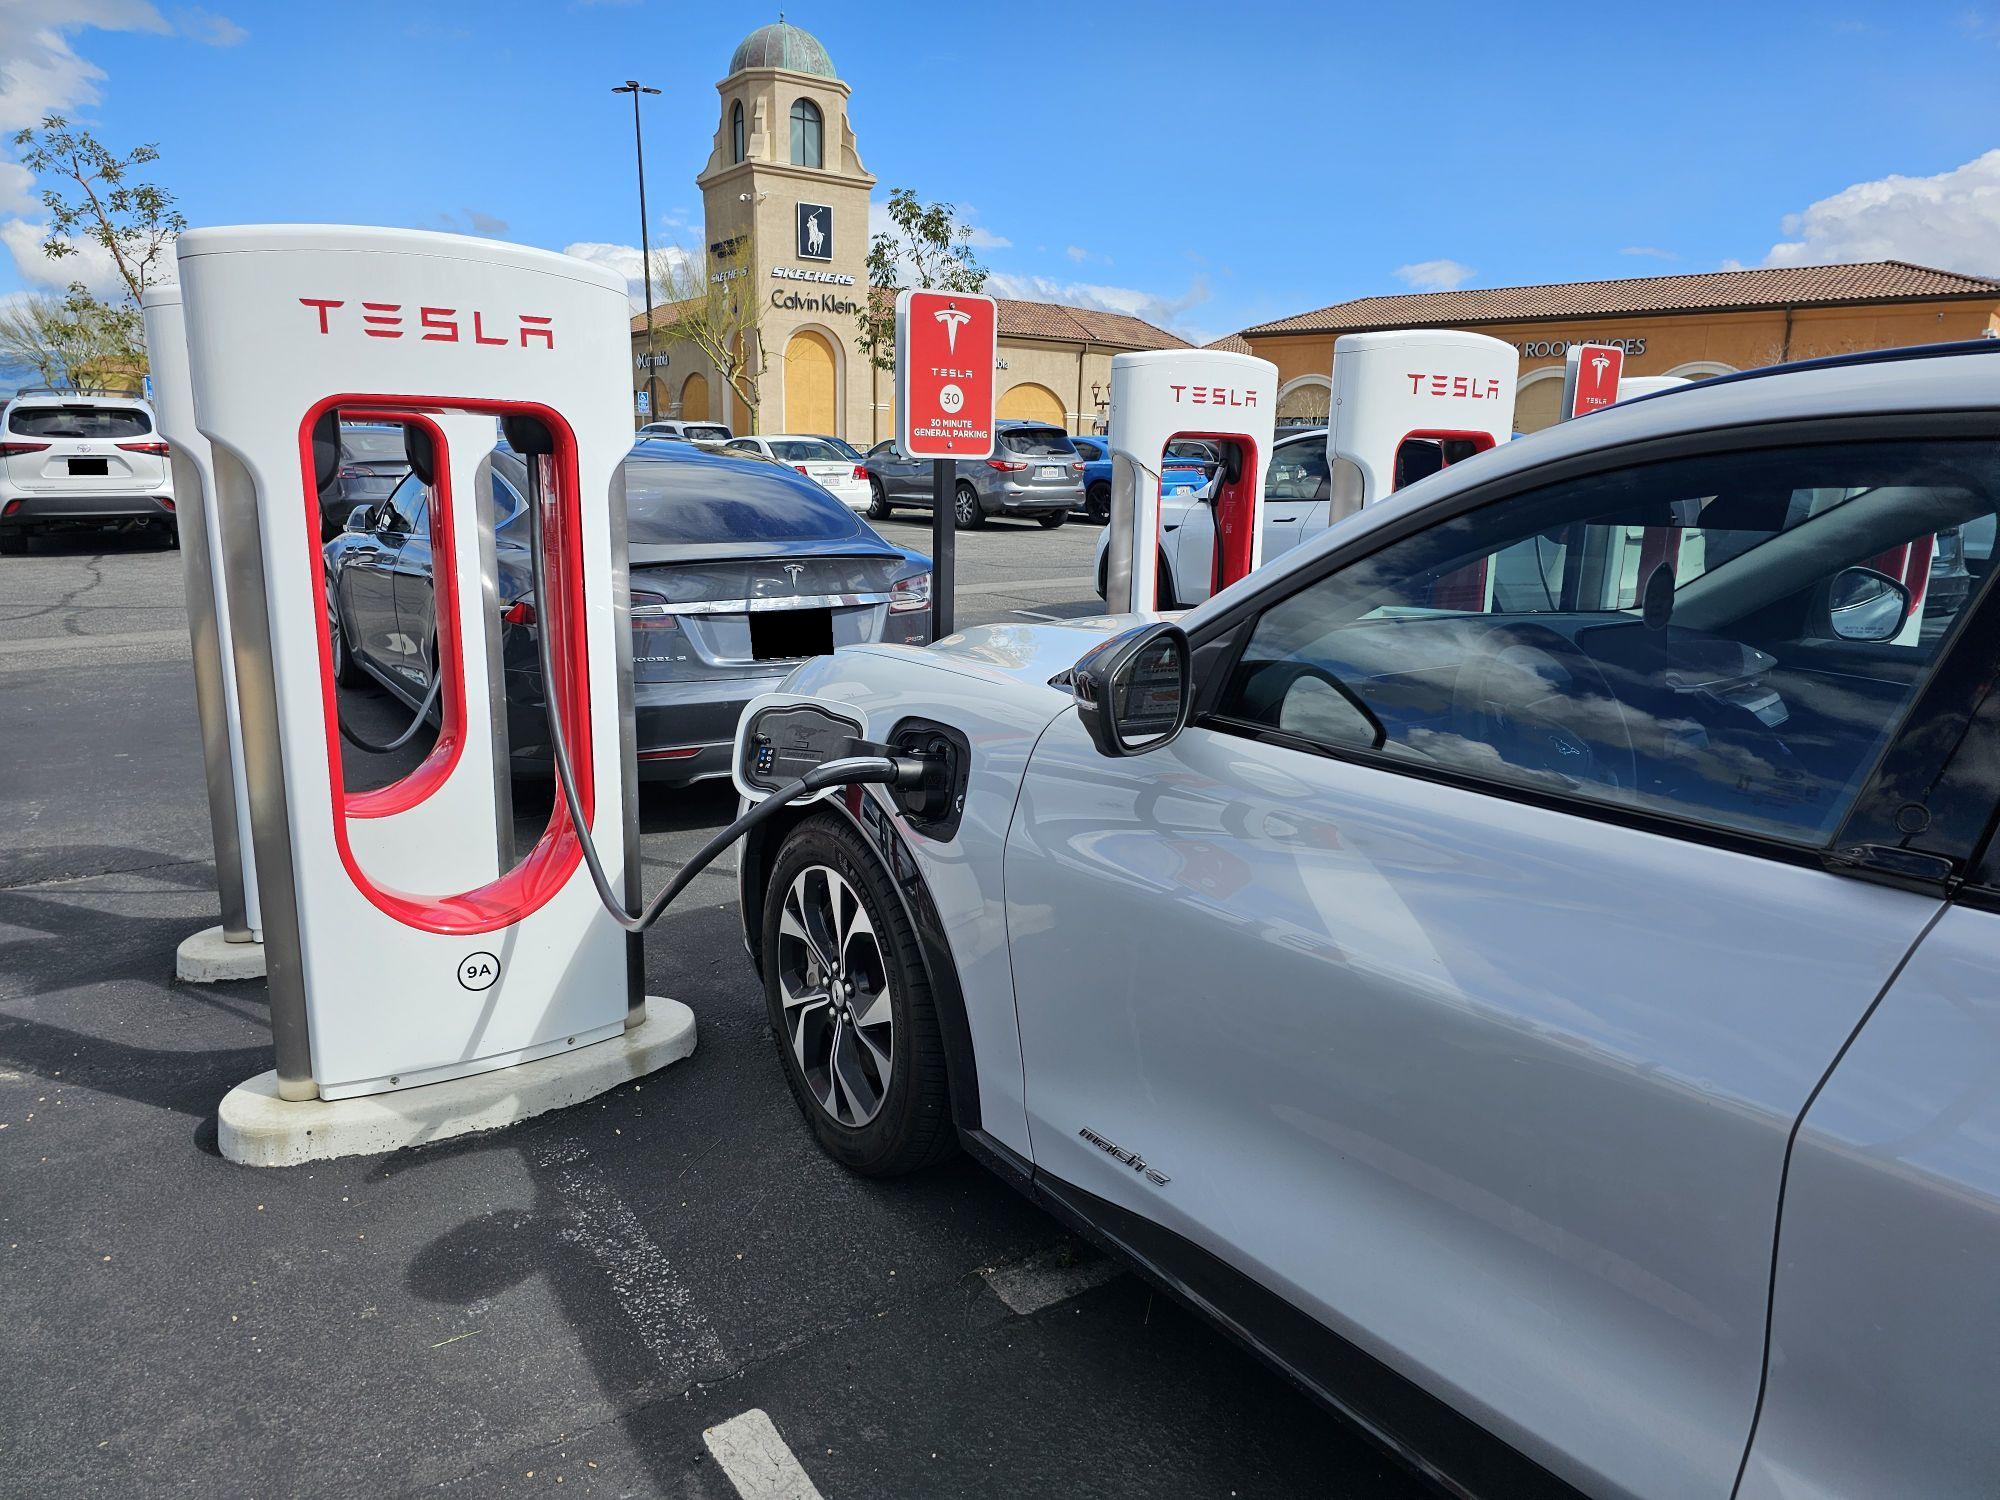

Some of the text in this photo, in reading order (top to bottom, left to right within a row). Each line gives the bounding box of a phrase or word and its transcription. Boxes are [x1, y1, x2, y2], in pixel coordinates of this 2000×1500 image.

[711, 266, 749, 284] SKECHES
[771, 267, 856, 286] SKECHERS
[771, 289, 858, 315] Calvin Klein
[299, 298, 554, 349] TESLA
[932, 368, 973, 379] TESLA
[1407, 374, 1499, 400] TESLA
[944, 393, 960, 405] 30
[1170, 385, 1257, 408] TESLA
[1586, 397, 1607, 405] TESLA
[931, 418, 972, 428] 30 MINUTE
[914, 428, 988, 439] GENERAL PARKING
[467, 964, 491, 978] 9A
